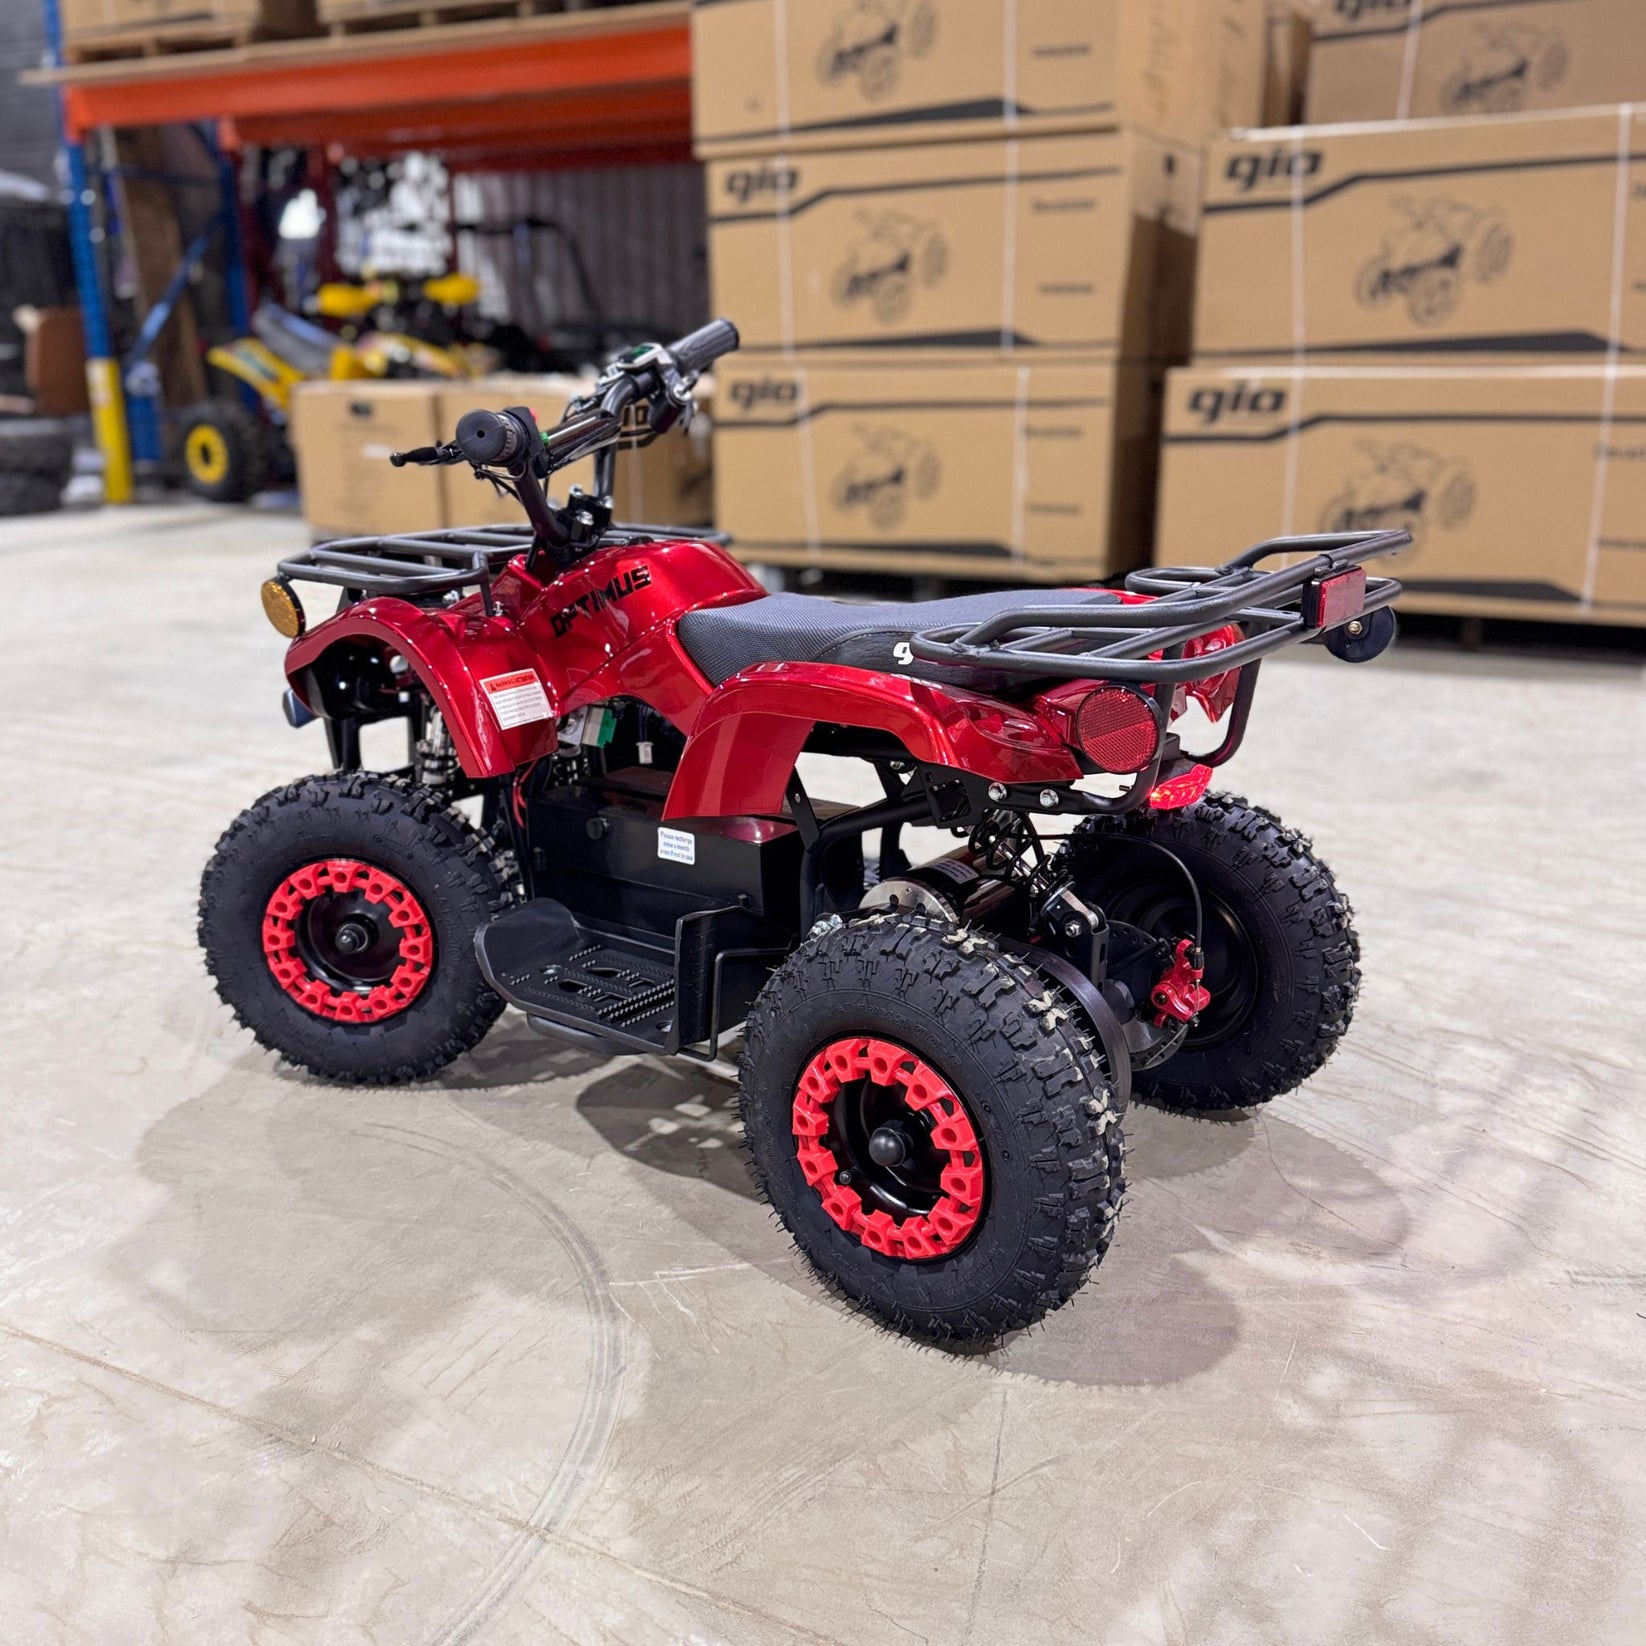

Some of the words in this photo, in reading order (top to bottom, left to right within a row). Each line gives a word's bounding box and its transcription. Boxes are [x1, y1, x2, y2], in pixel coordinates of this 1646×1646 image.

[726, 167, 798, 204] gio
[1227, 148, 1322, 192] gio
[731, 377, 798, 411] gio
[1188, 382, 1285, 424] gio
[550, 565, 652, 638] OPTIMUS
